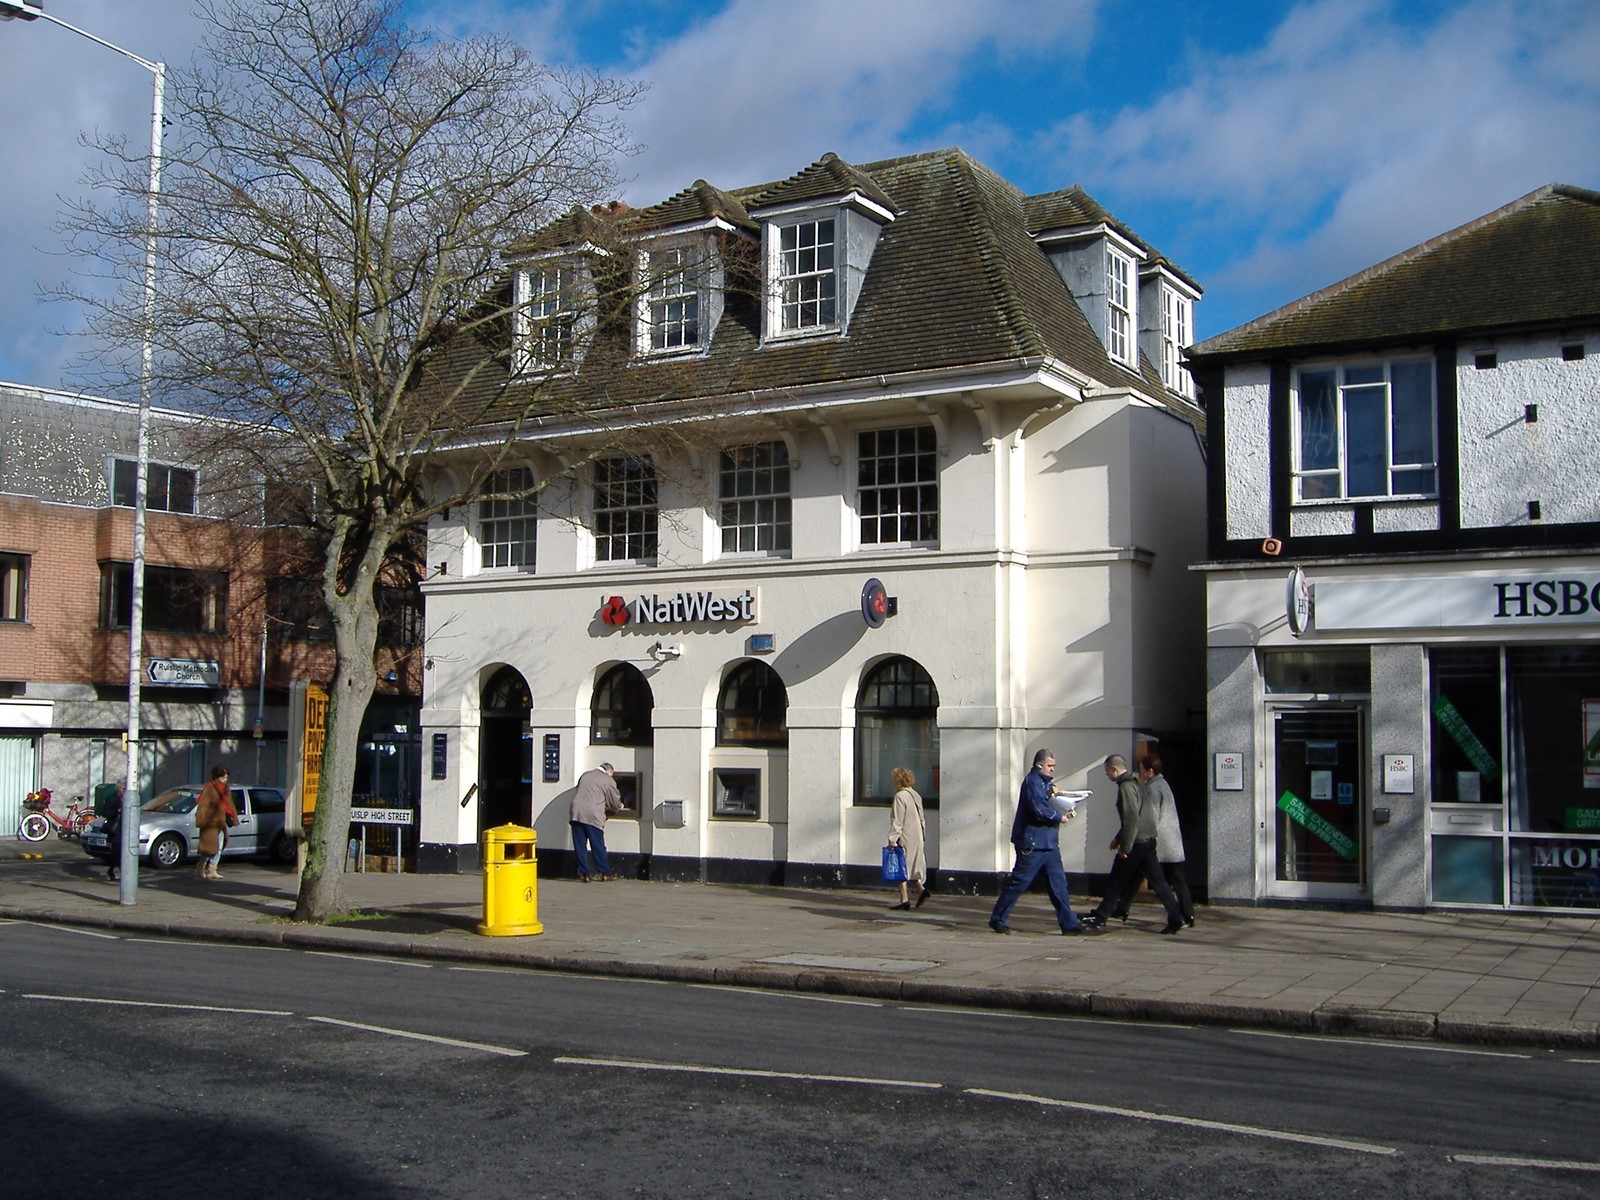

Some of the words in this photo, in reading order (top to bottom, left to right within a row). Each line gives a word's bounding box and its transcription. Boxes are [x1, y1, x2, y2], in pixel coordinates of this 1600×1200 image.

[635, 591, 752, 624] NatWest
[158, 663, 181, 673] Ruislip
[183, 664, 217, 673] Methodist
[176, 672, 201, 680] Church
[351, 810, 369, 819] UISLIP
[370, 811, 386, 820] HIGH
[387, 811, 410, 821] STREET
[1284, 803, 1305, 825] UNTIL
[1316, 829, 1331, 842] FEB
[1289, 797, 1312, 817] SALE
[1311, 812, 1353, 848] EXTENDED
